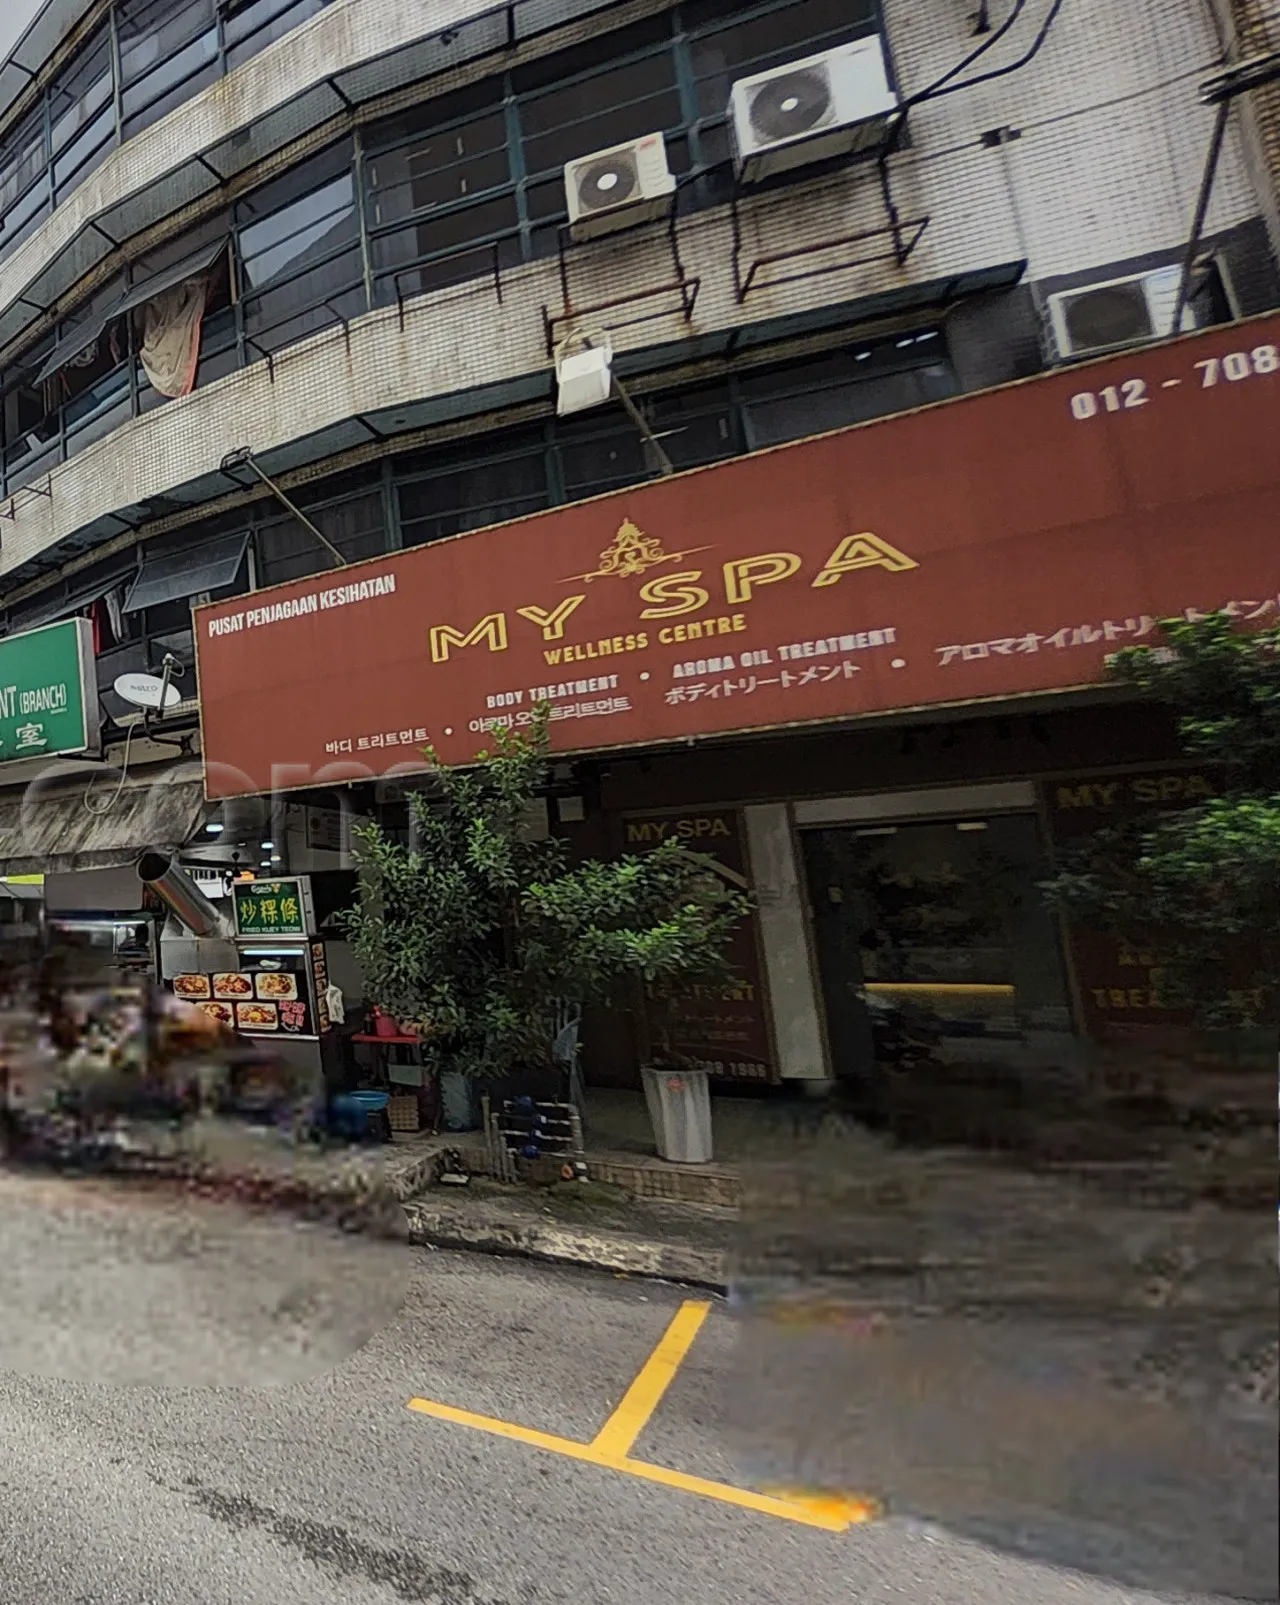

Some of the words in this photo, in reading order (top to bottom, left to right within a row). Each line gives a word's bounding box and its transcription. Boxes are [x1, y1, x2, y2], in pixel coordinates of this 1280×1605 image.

[1071, 378, 1150, 420] 012
[1193, 345, 1280, 389] 708
[208, 613, 244, 638] PUSAT
[246, 595, 317, 629] PENJAGAAN
[320, 574, 396, 610] KESIHATAN
[429, 595, 586, 664] MY
[639, 532, 920, 621] SPA
[544, 633, 648, 666] WELLNESS
[658, 614, 747, 644] CENTRE
[672, 656, 735, 679] AROMA
[740, 649, 773, 667] OIL
[777, 628, 897, 662] TREATMENT
[19, 683, 67, 715] (BRANCH)
[486, 690, 524, 709] BODY
[530, 674, 619, 702] TREATMENT
[325, 738, 352, 755] 바디
[357, 728, 430, 750] 트리트먼트
[1057, 781, 1121, 809] MY
[1131, 775, 1217, 802] SPA
[627, 823, 668, 843] MY
[677, 818, 731, 838] SPA
